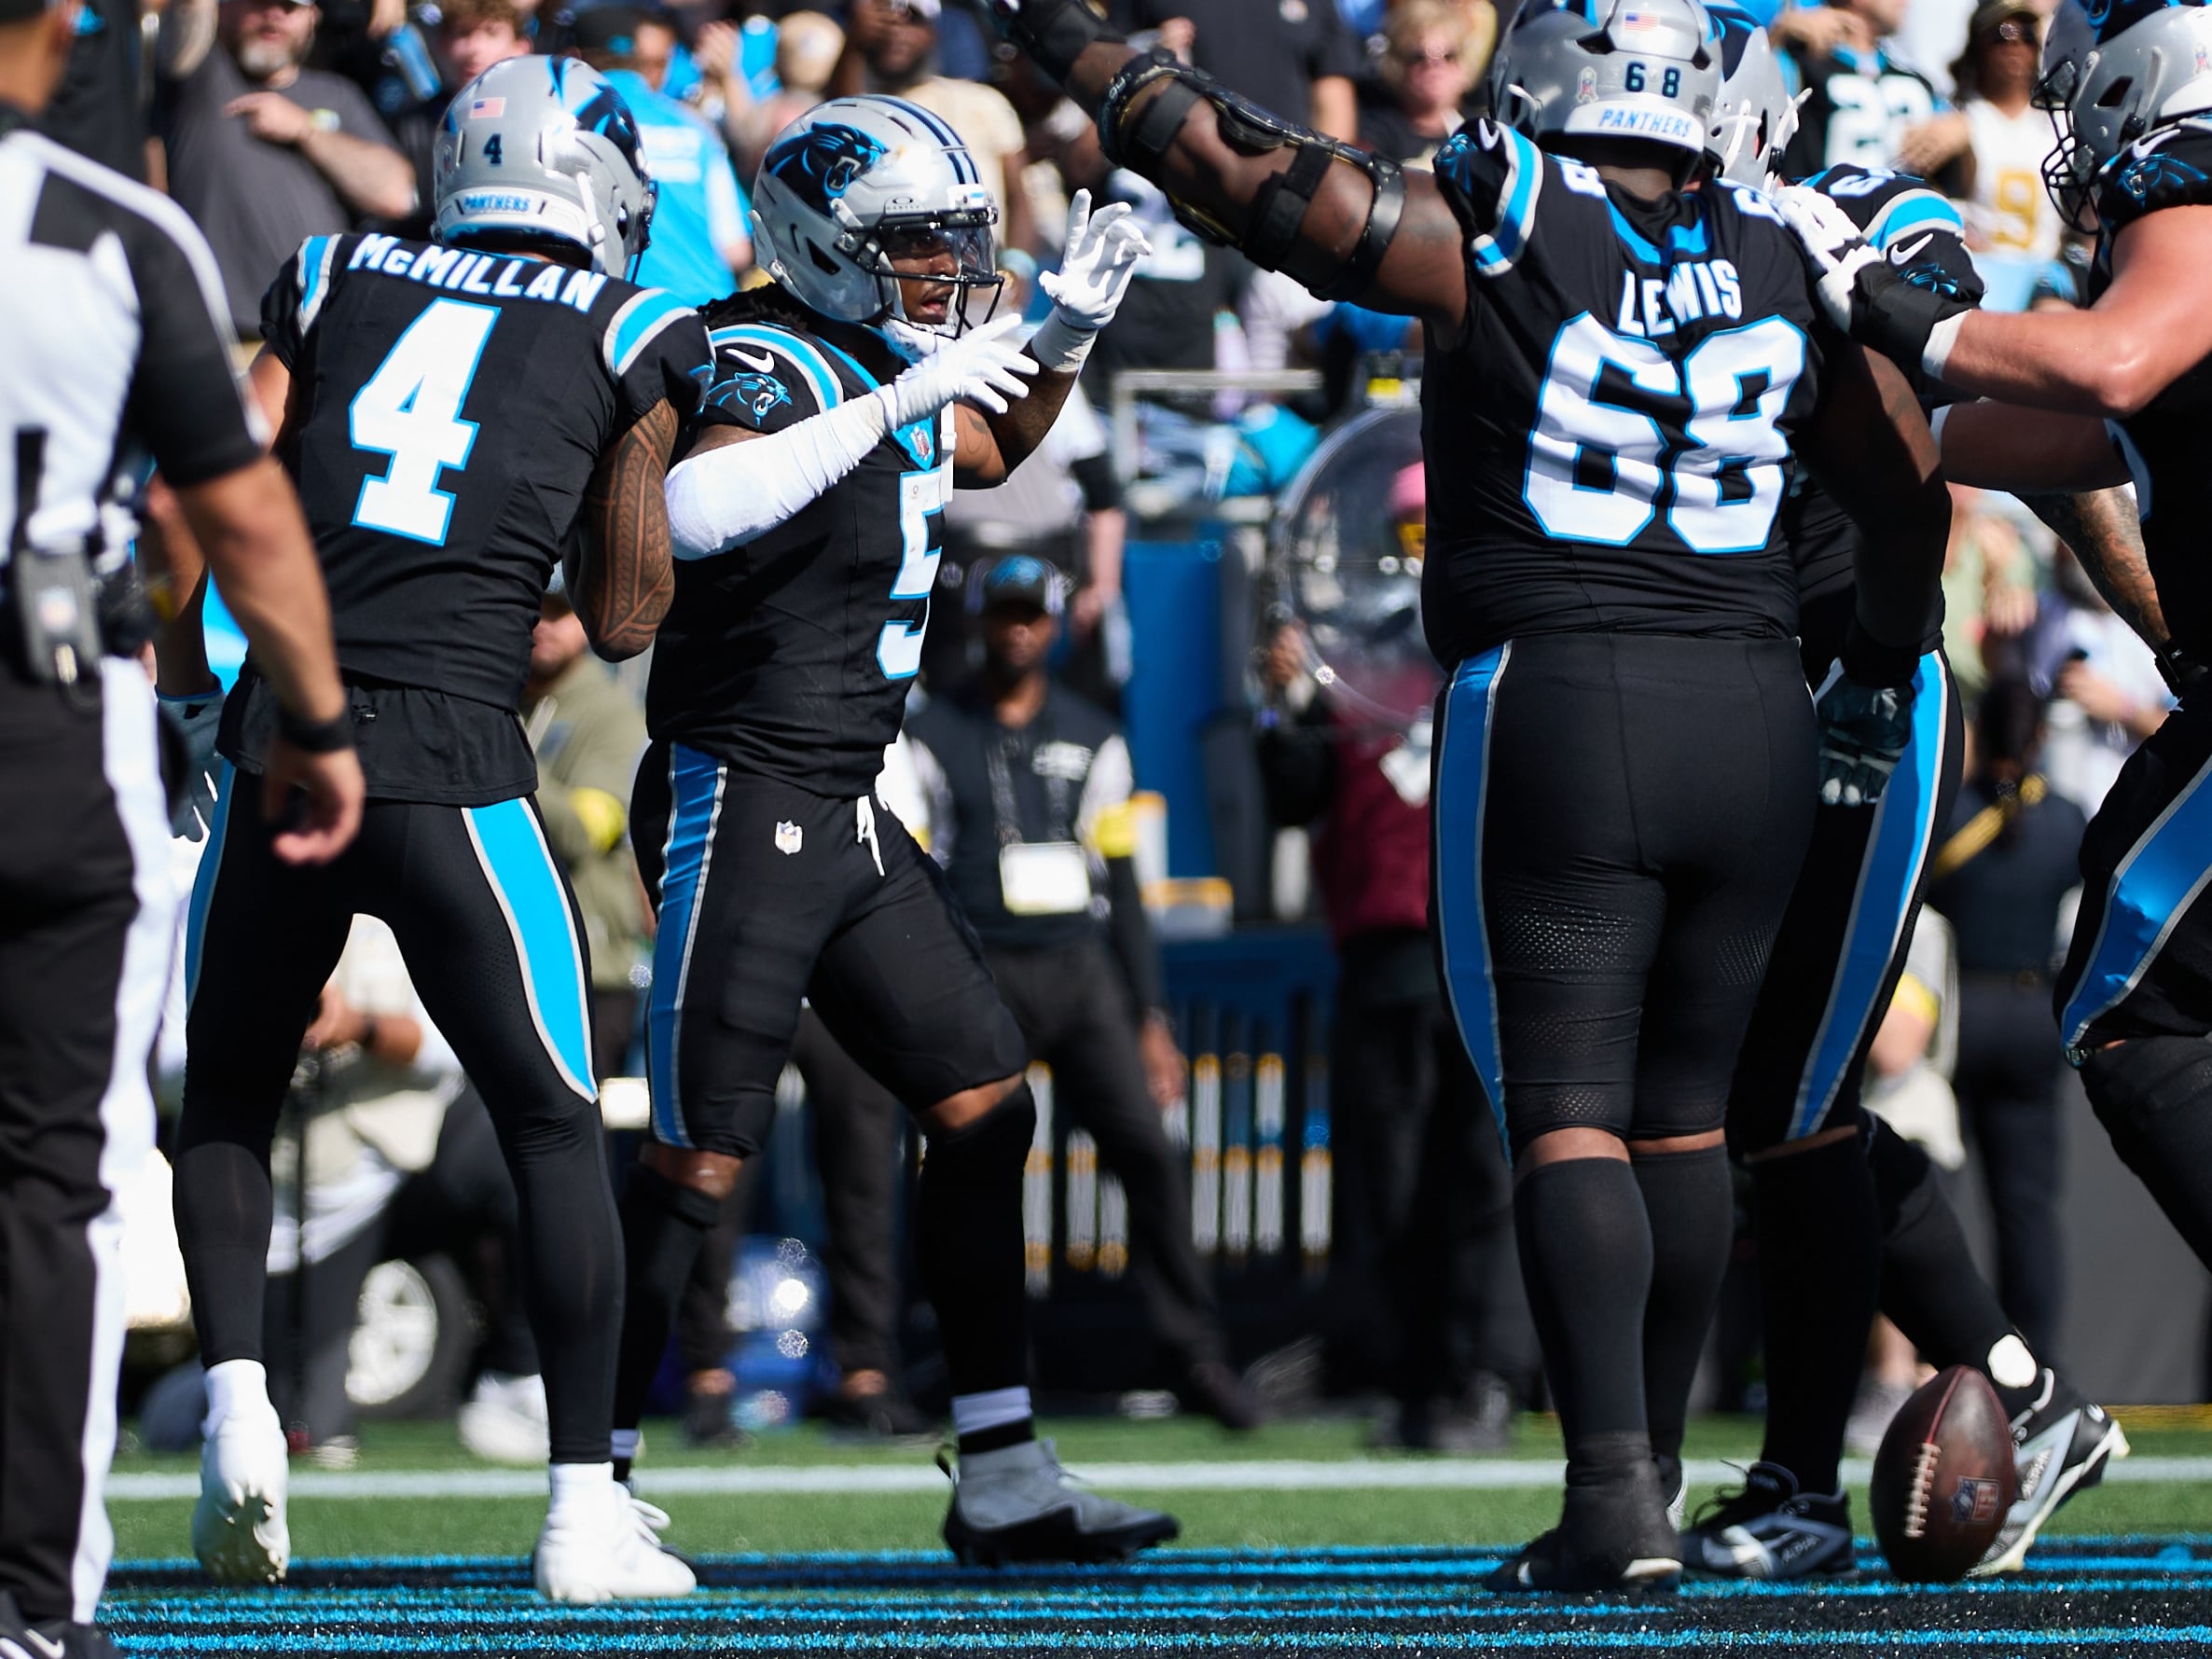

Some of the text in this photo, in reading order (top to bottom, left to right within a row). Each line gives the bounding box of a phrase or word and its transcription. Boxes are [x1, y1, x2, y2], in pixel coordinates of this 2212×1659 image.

[483, 132, 504, 165] 4
[1597, 108, 1693, 138] PANTHERS
[464, 193, 532, 213] PANTHERS
[1995, 169, 2039, 251] 9
[348, 233, 609, 314] McMILLAN
[1616, 258, 1743, 339] LEWIS
[348, 296, 503, 547] 4
[1521, 310, 1808, 555] 68
[876, 467, 947, 681] 5
